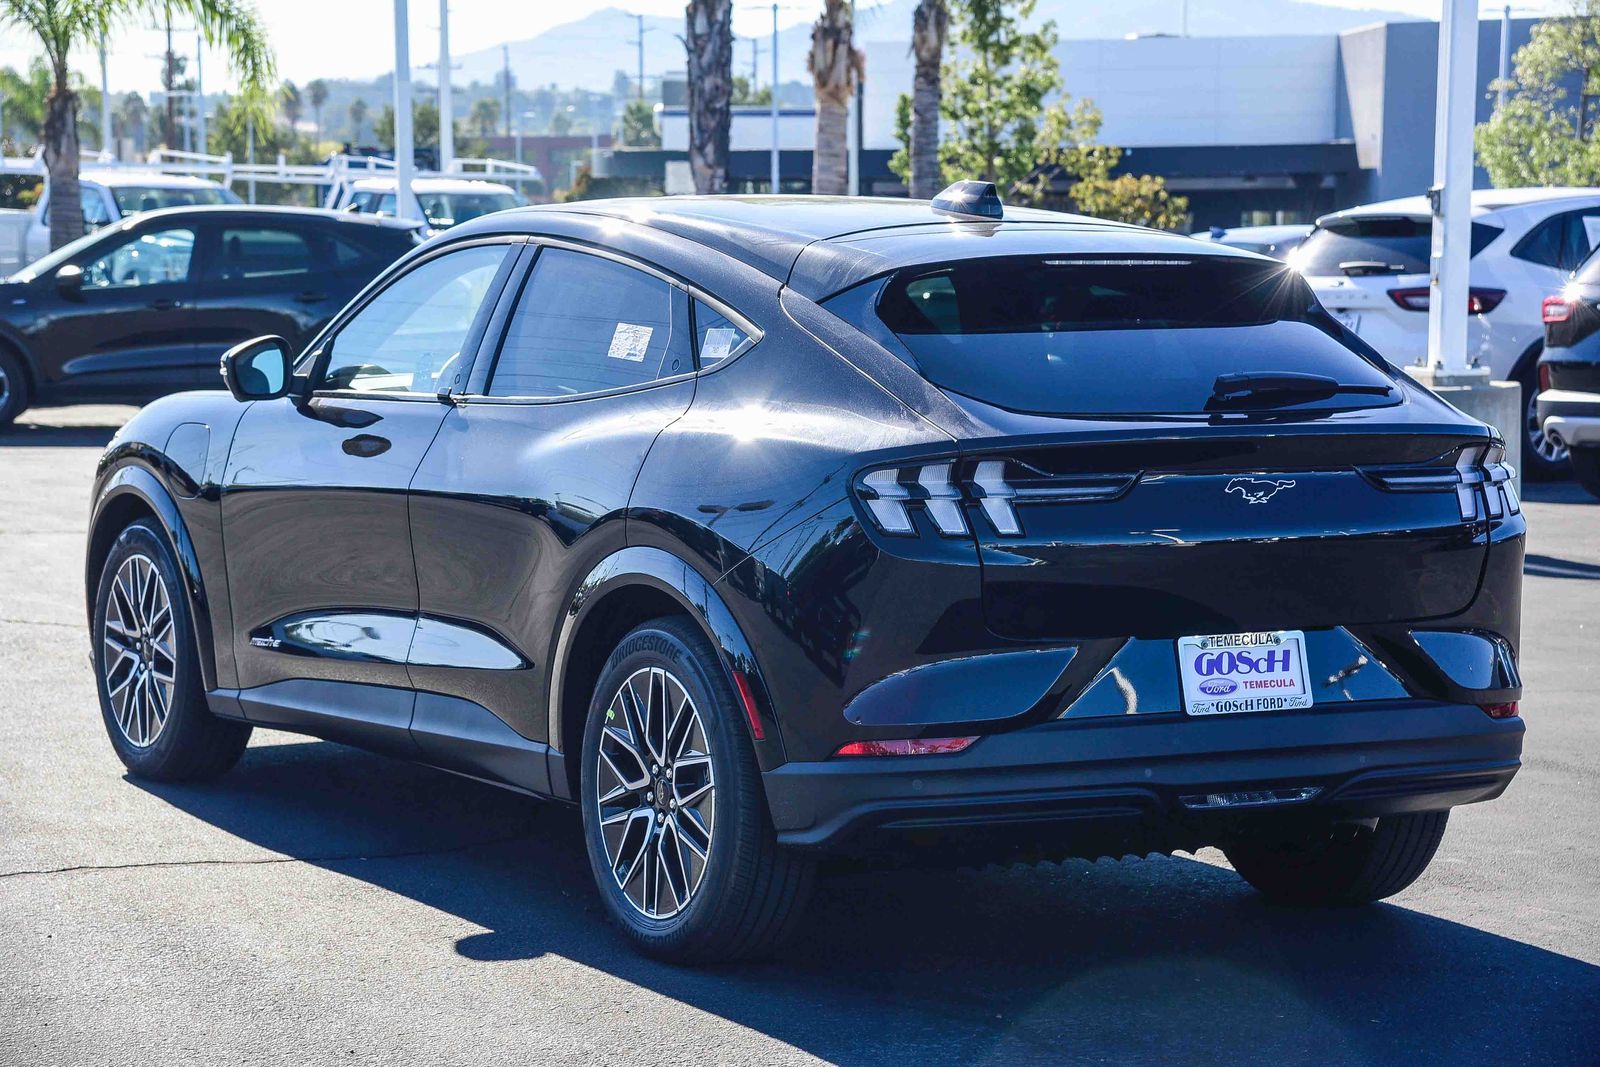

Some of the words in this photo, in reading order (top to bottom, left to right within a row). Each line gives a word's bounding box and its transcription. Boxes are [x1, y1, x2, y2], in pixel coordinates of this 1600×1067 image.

[1208, 633, 1274, 648] TEMECULA
[610, 635, 682, 672] BRIDGESTONE
[1204, 680, 1233, 695] Ford
[1243, 678, 1296, 690] TEMECULA
[1256, 697, 1284, 710] FORD
